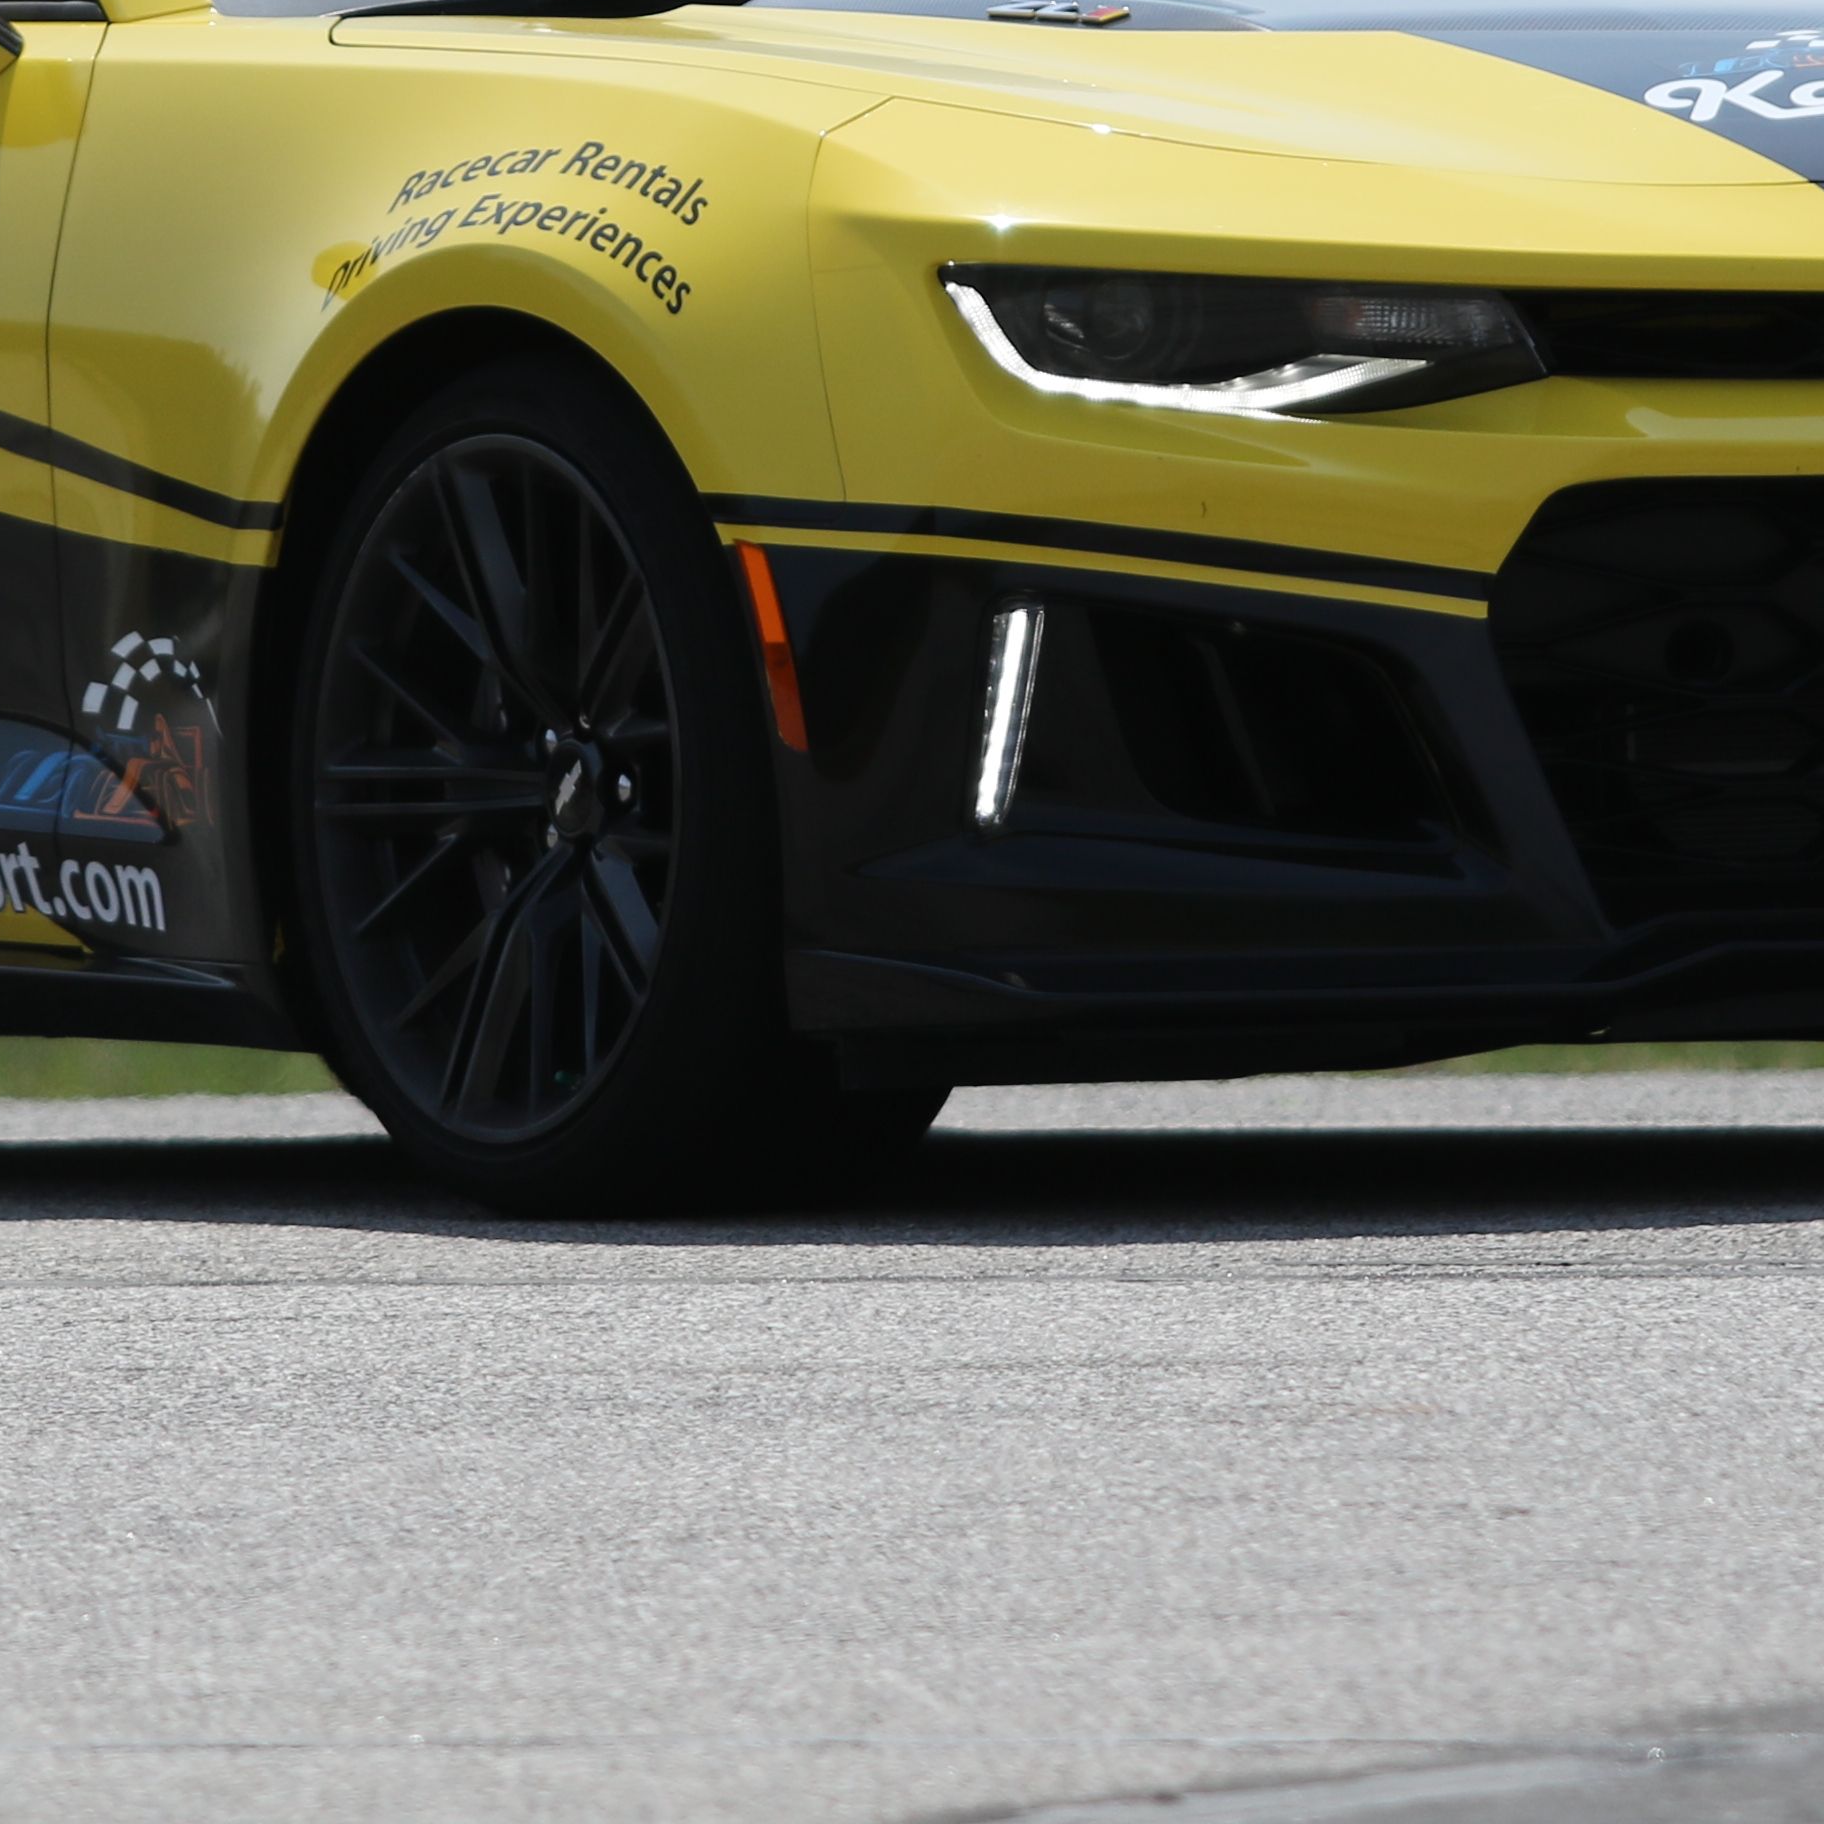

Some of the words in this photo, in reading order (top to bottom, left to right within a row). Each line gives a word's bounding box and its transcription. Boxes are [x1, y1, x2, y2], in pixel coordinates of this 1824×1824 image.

[388, 145, 563, 214] Racecar
[559, 140, 710, 226] Rentals
[321, 206, 459, 313] Driving
[456, 193, 691, 314] Experiences
